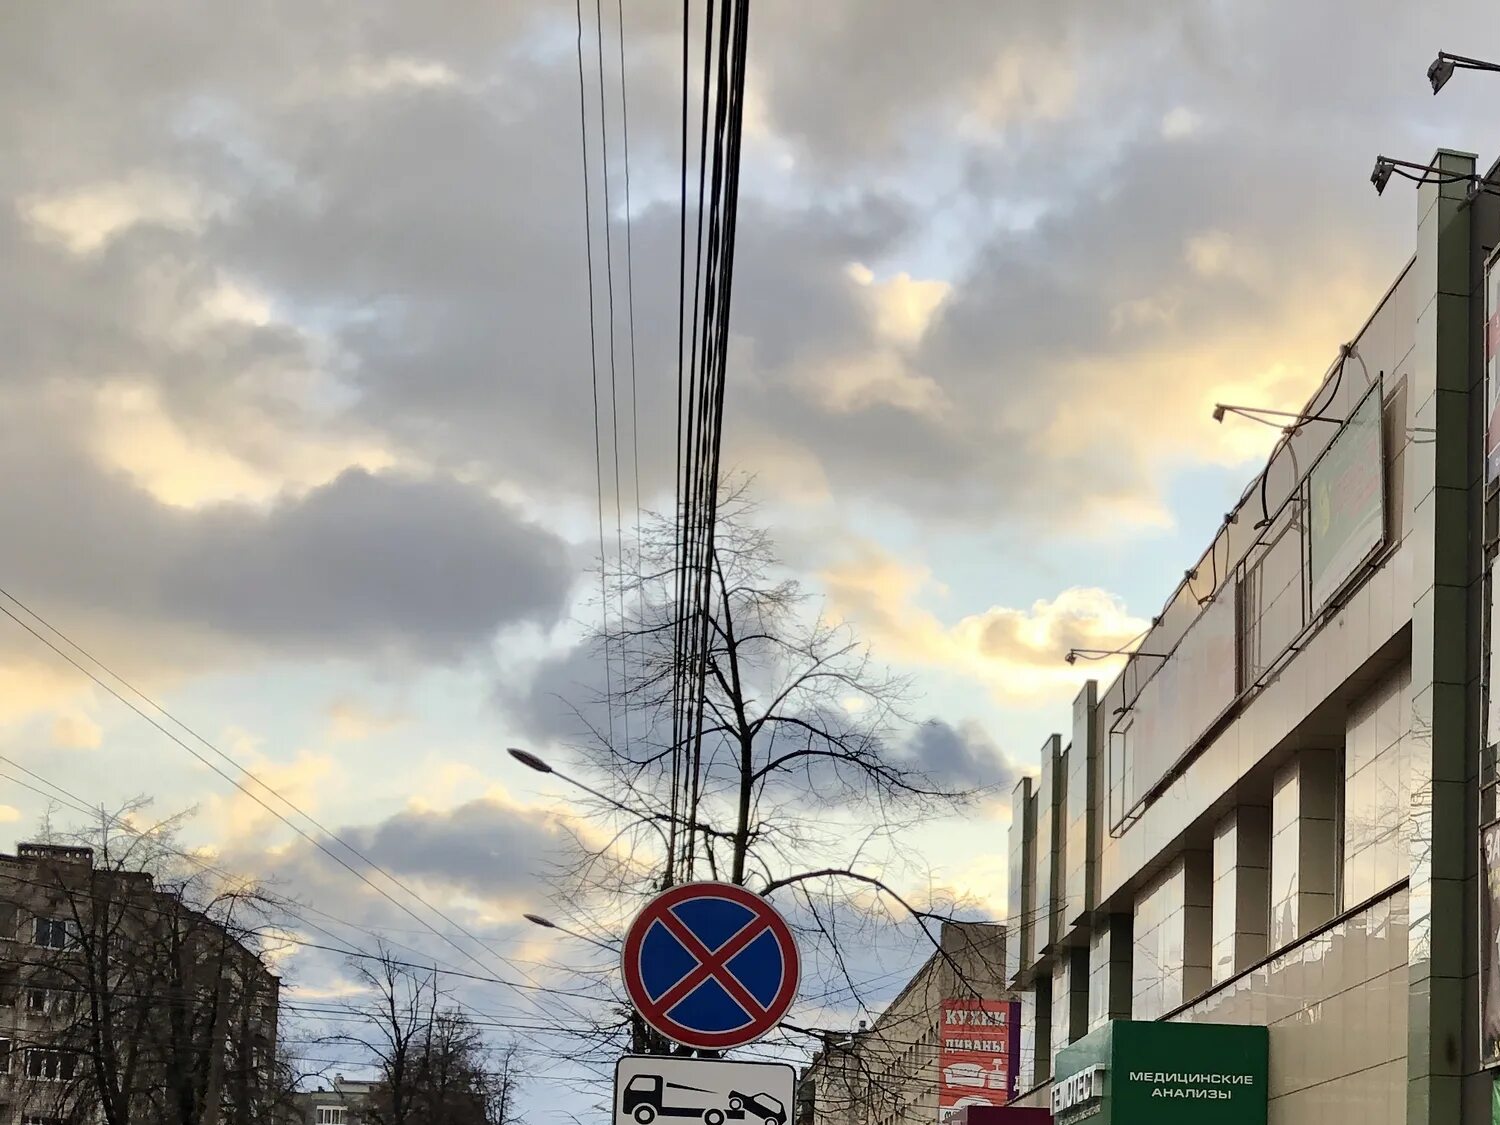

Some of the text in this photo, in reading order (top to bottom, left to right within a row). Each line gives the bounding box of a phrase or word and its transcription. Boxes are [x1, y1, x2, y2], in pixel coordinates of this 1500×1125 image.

[946, 1009, 1006, 1026] КУХНИ
[945, 1039, 1005, 1053] ДИВАНЫ
[1129, 1071, 1253, 1085] МЕДИЦИНСКИЕ
[1151, 1088, 1231, 1099] АНАЛИЗЫ
